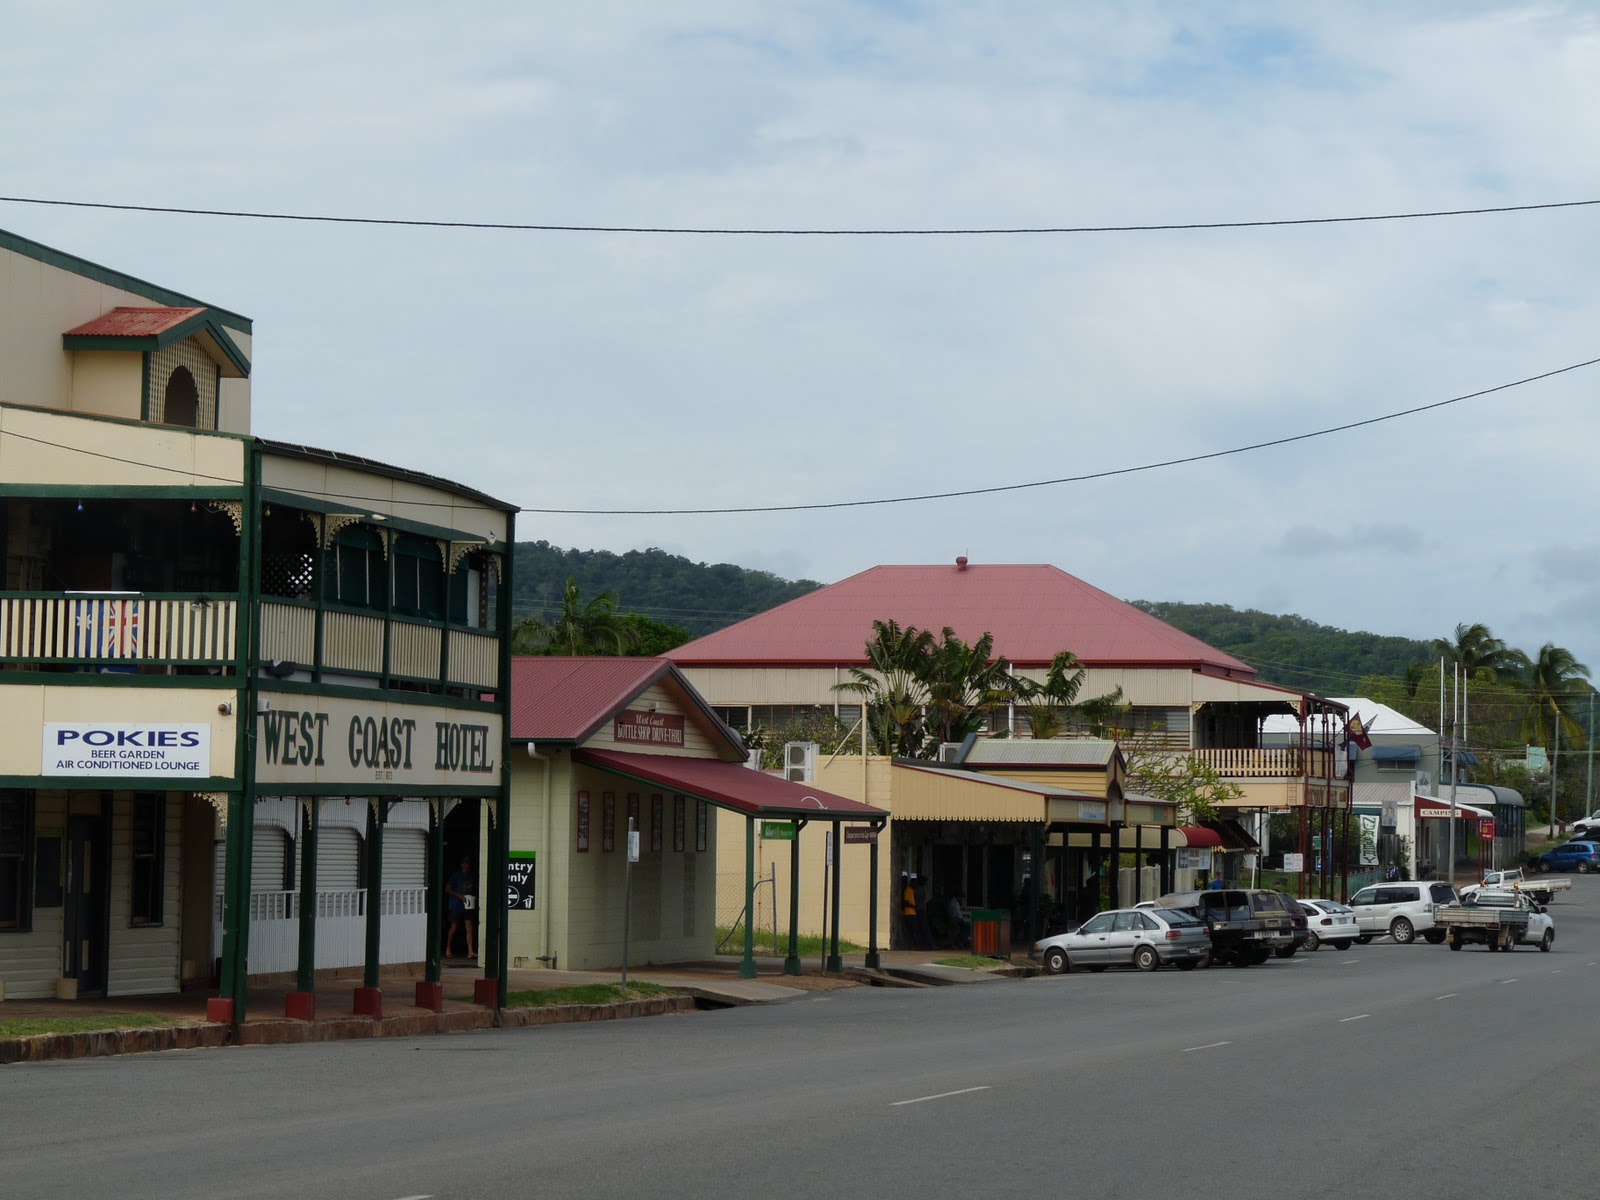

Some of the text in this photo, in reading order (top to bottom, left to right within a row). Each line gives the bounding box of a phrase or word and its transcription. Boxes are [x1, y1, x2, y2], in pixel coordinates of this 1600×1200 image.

[650, 715, 664, 726] Coast
[57, 730, 200, 747] POKIES
[617, 723, 682, 743] BOTTLE SHOP DRIVE-THRU
[263, 710, 494, 774] WEST COAST HOTEL
[91, 750, 165, 759] BEER GARDEN
[56, 760, 200, 771] AIR CONDITIONED LOUNGE
[508, 862, 534, 873] ntry
[508, 872, 528, 885] nly
